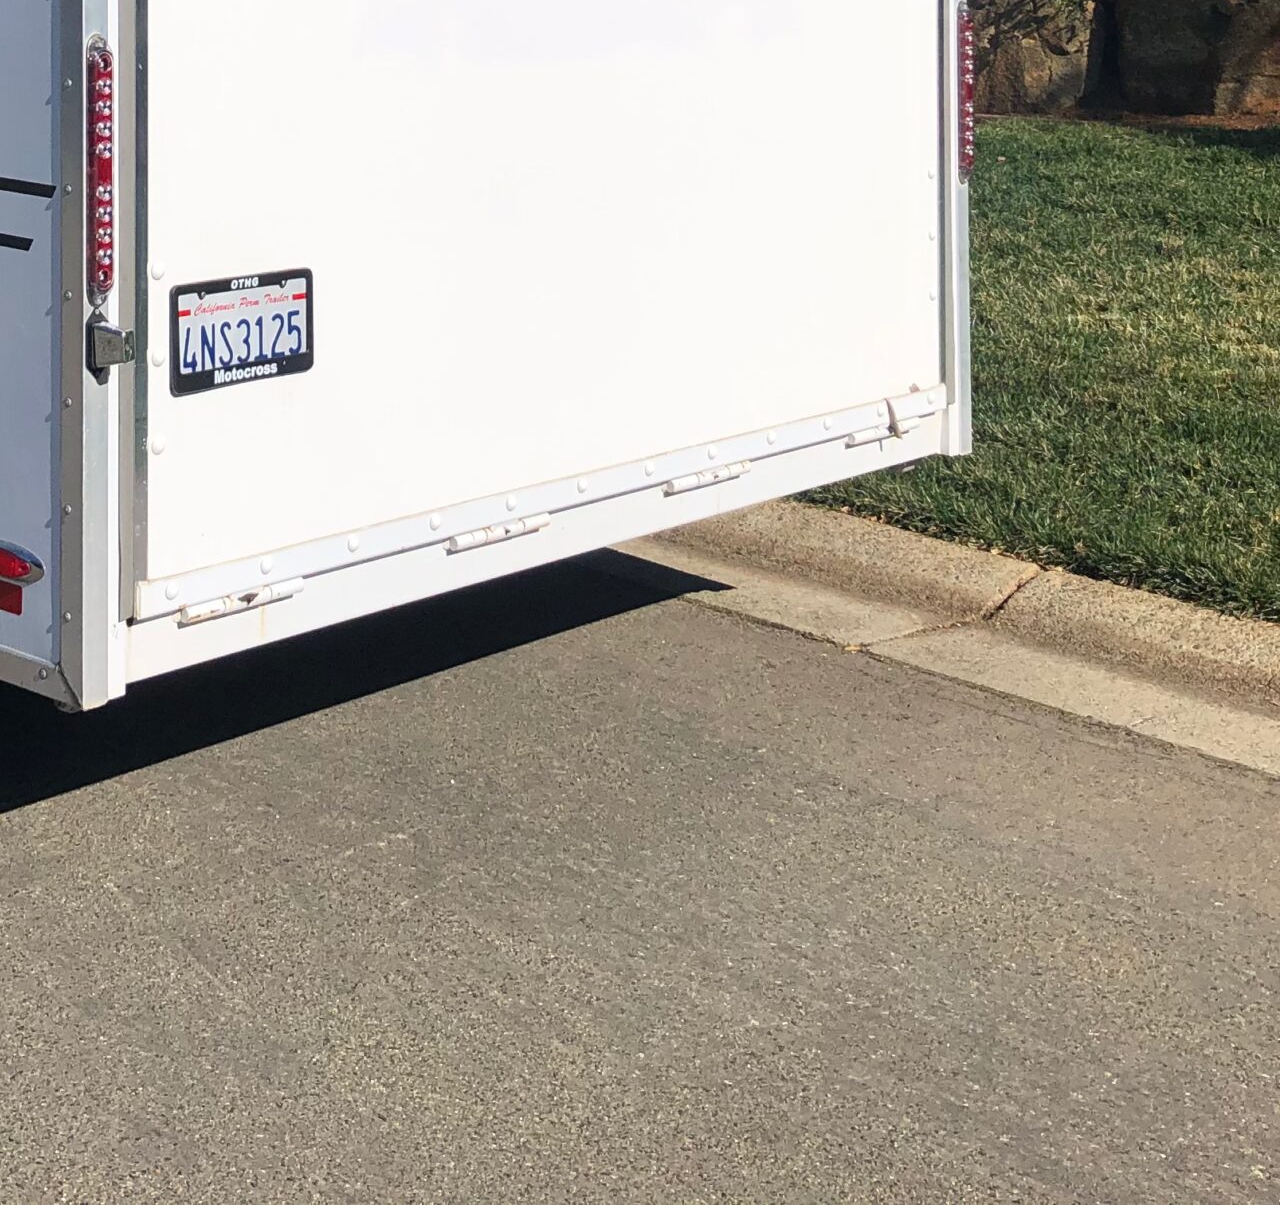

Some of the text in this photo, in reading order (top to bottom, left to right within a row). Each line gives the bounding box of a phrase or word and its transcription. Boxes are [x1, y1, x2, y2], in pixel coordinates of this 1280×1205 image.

[231, 277, 259, 289] OTHG
[194, 293, 289, 316] California Perm Trailer
[183, 310, 302, 373] 4NS3125
[214, 363, 277, 384] Motocross
